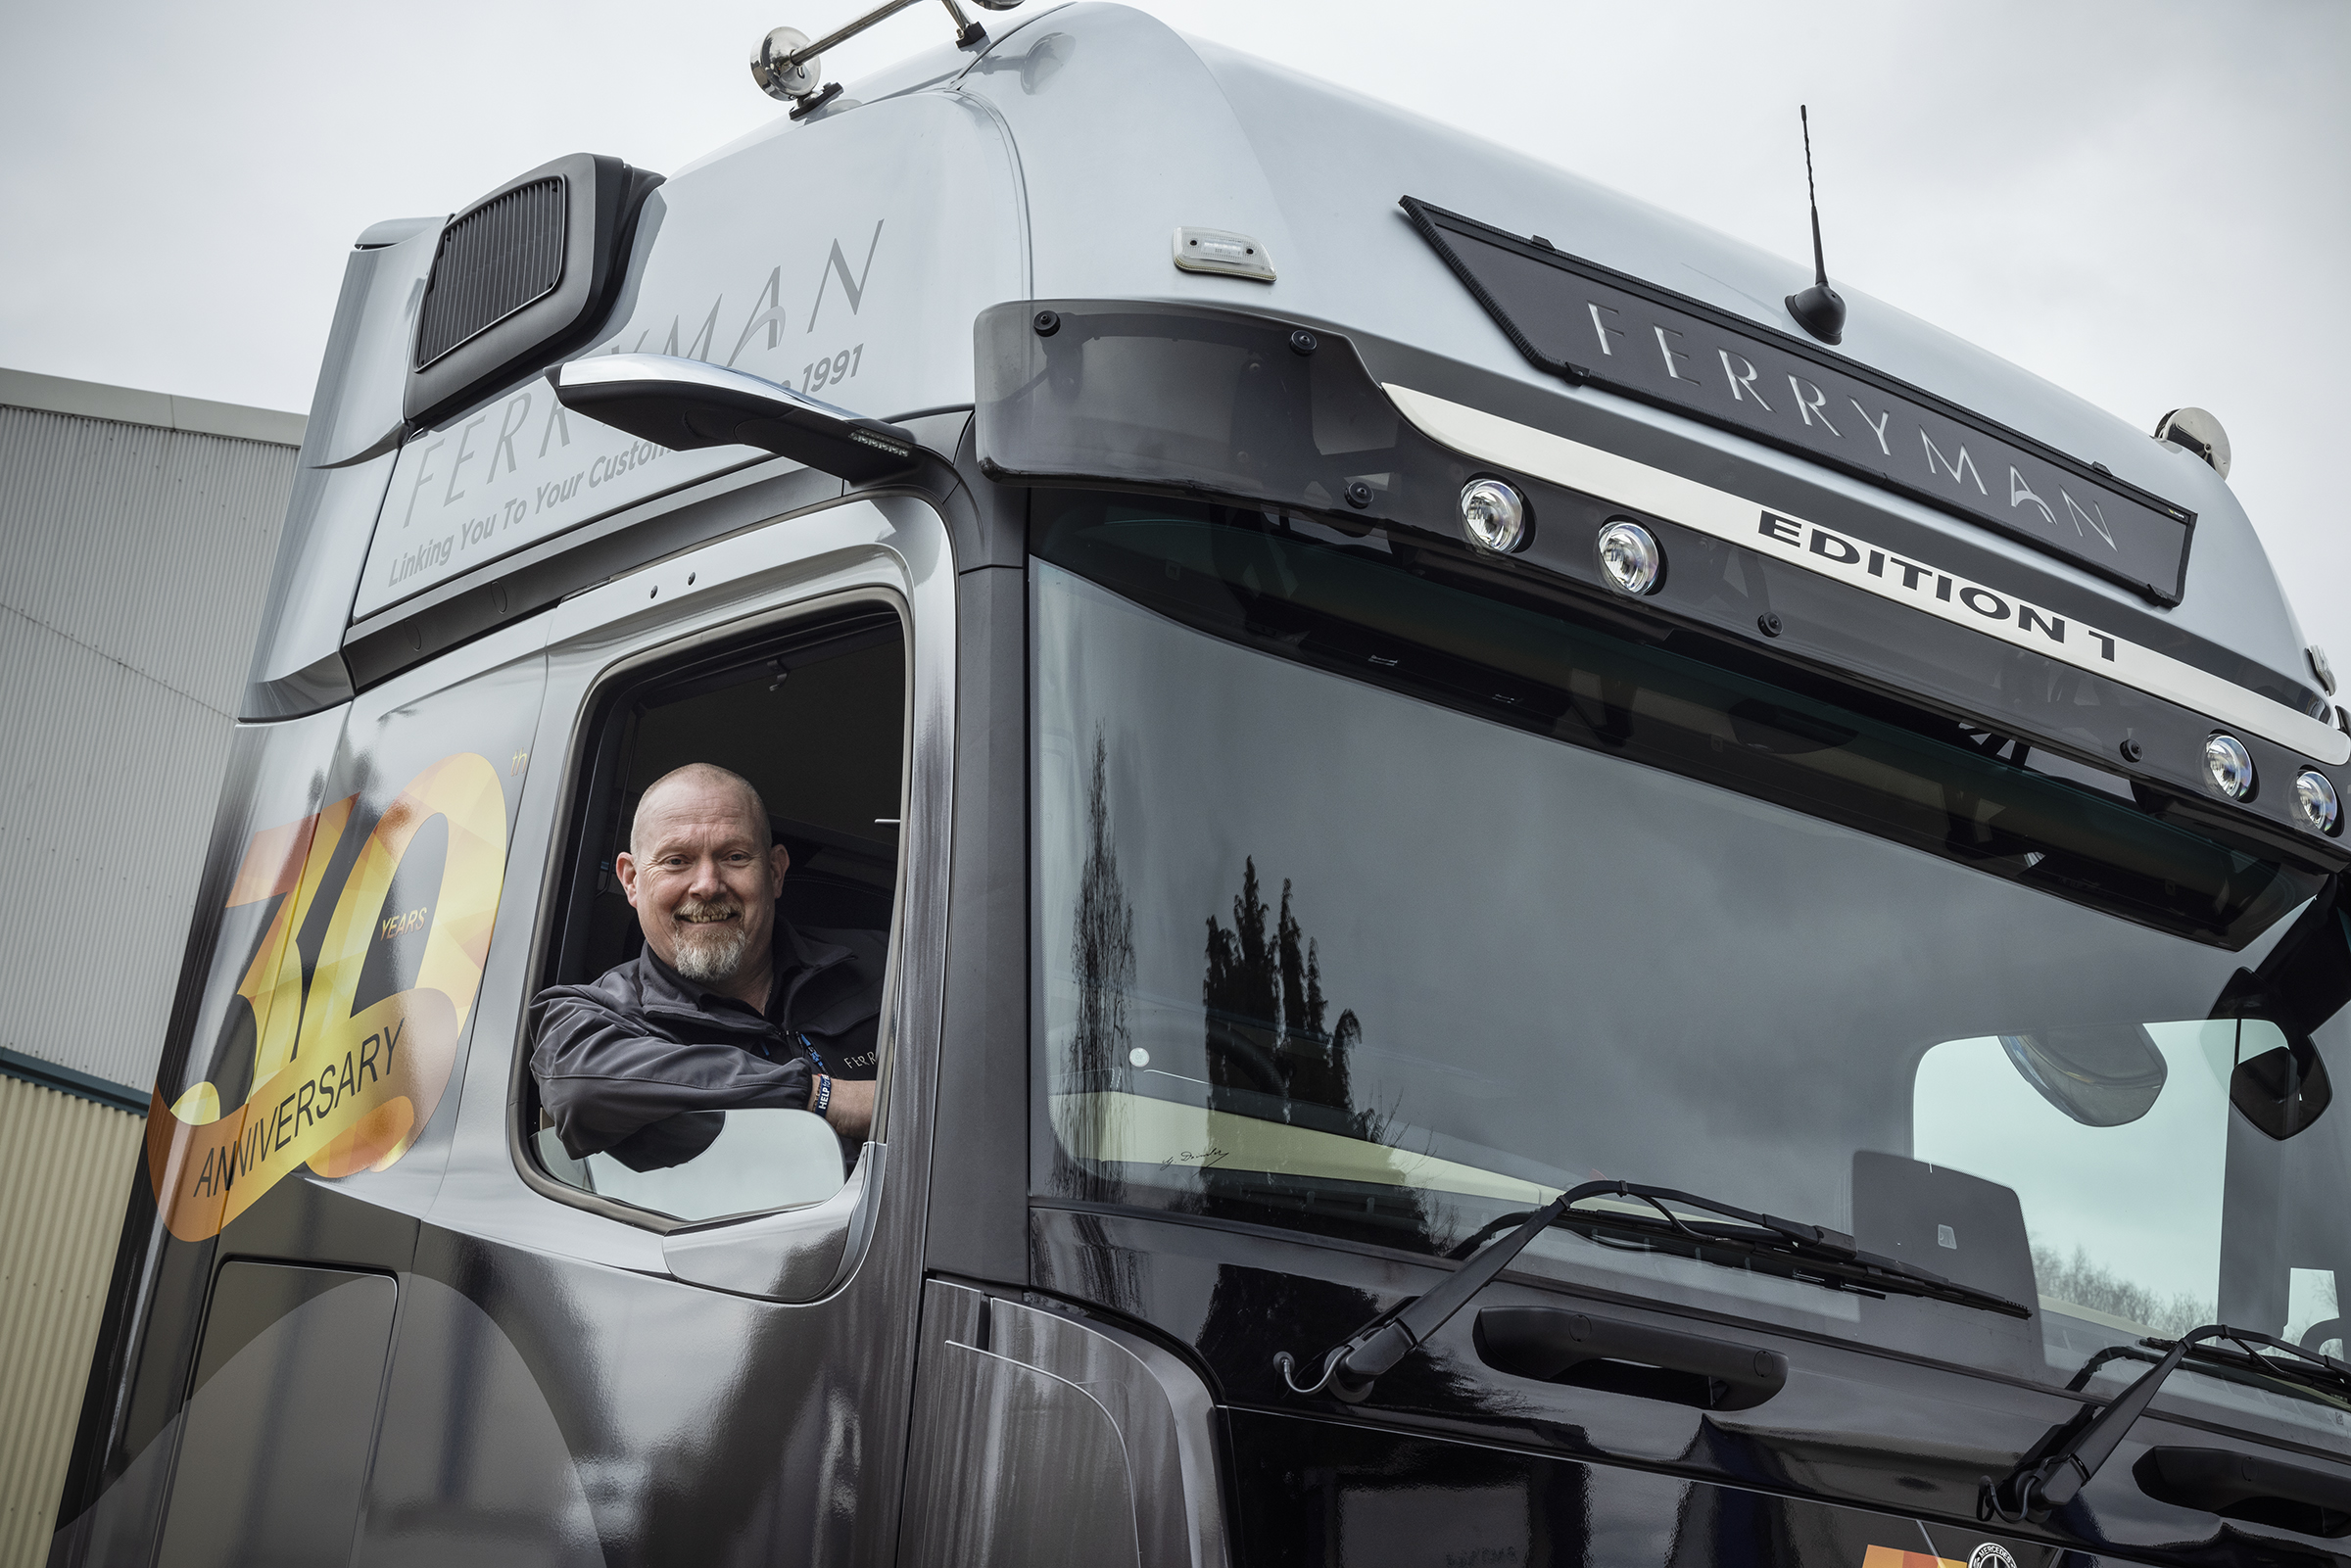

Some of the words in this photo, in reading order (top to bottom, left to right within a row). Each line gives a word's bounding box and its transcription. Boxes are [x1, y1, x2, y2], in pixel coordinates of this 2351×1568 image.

[1587, 299, 2120, 553] FERRYMAN
[388, 534, 455, 589] Linking
[460, 513, 498, 551] You
[502, 498, 528, 531] To
[535, 470, 586, 515] Your
[801, 343, 865, 396] 1991
[1757, 509, 2066, 644] EDITION
[2087, 629, 2116, 663] 1
[510, 747, 528, 777] th
[379, 906, 428, 942] YEARS
[843, 1051, 877, 1069] FERR
[192, 1016, 406, 1199] ANNIVERSARY
[818, 1086, 830, 1110] HELP
[1979, 1546, 2012, 1562] MERCEDES
